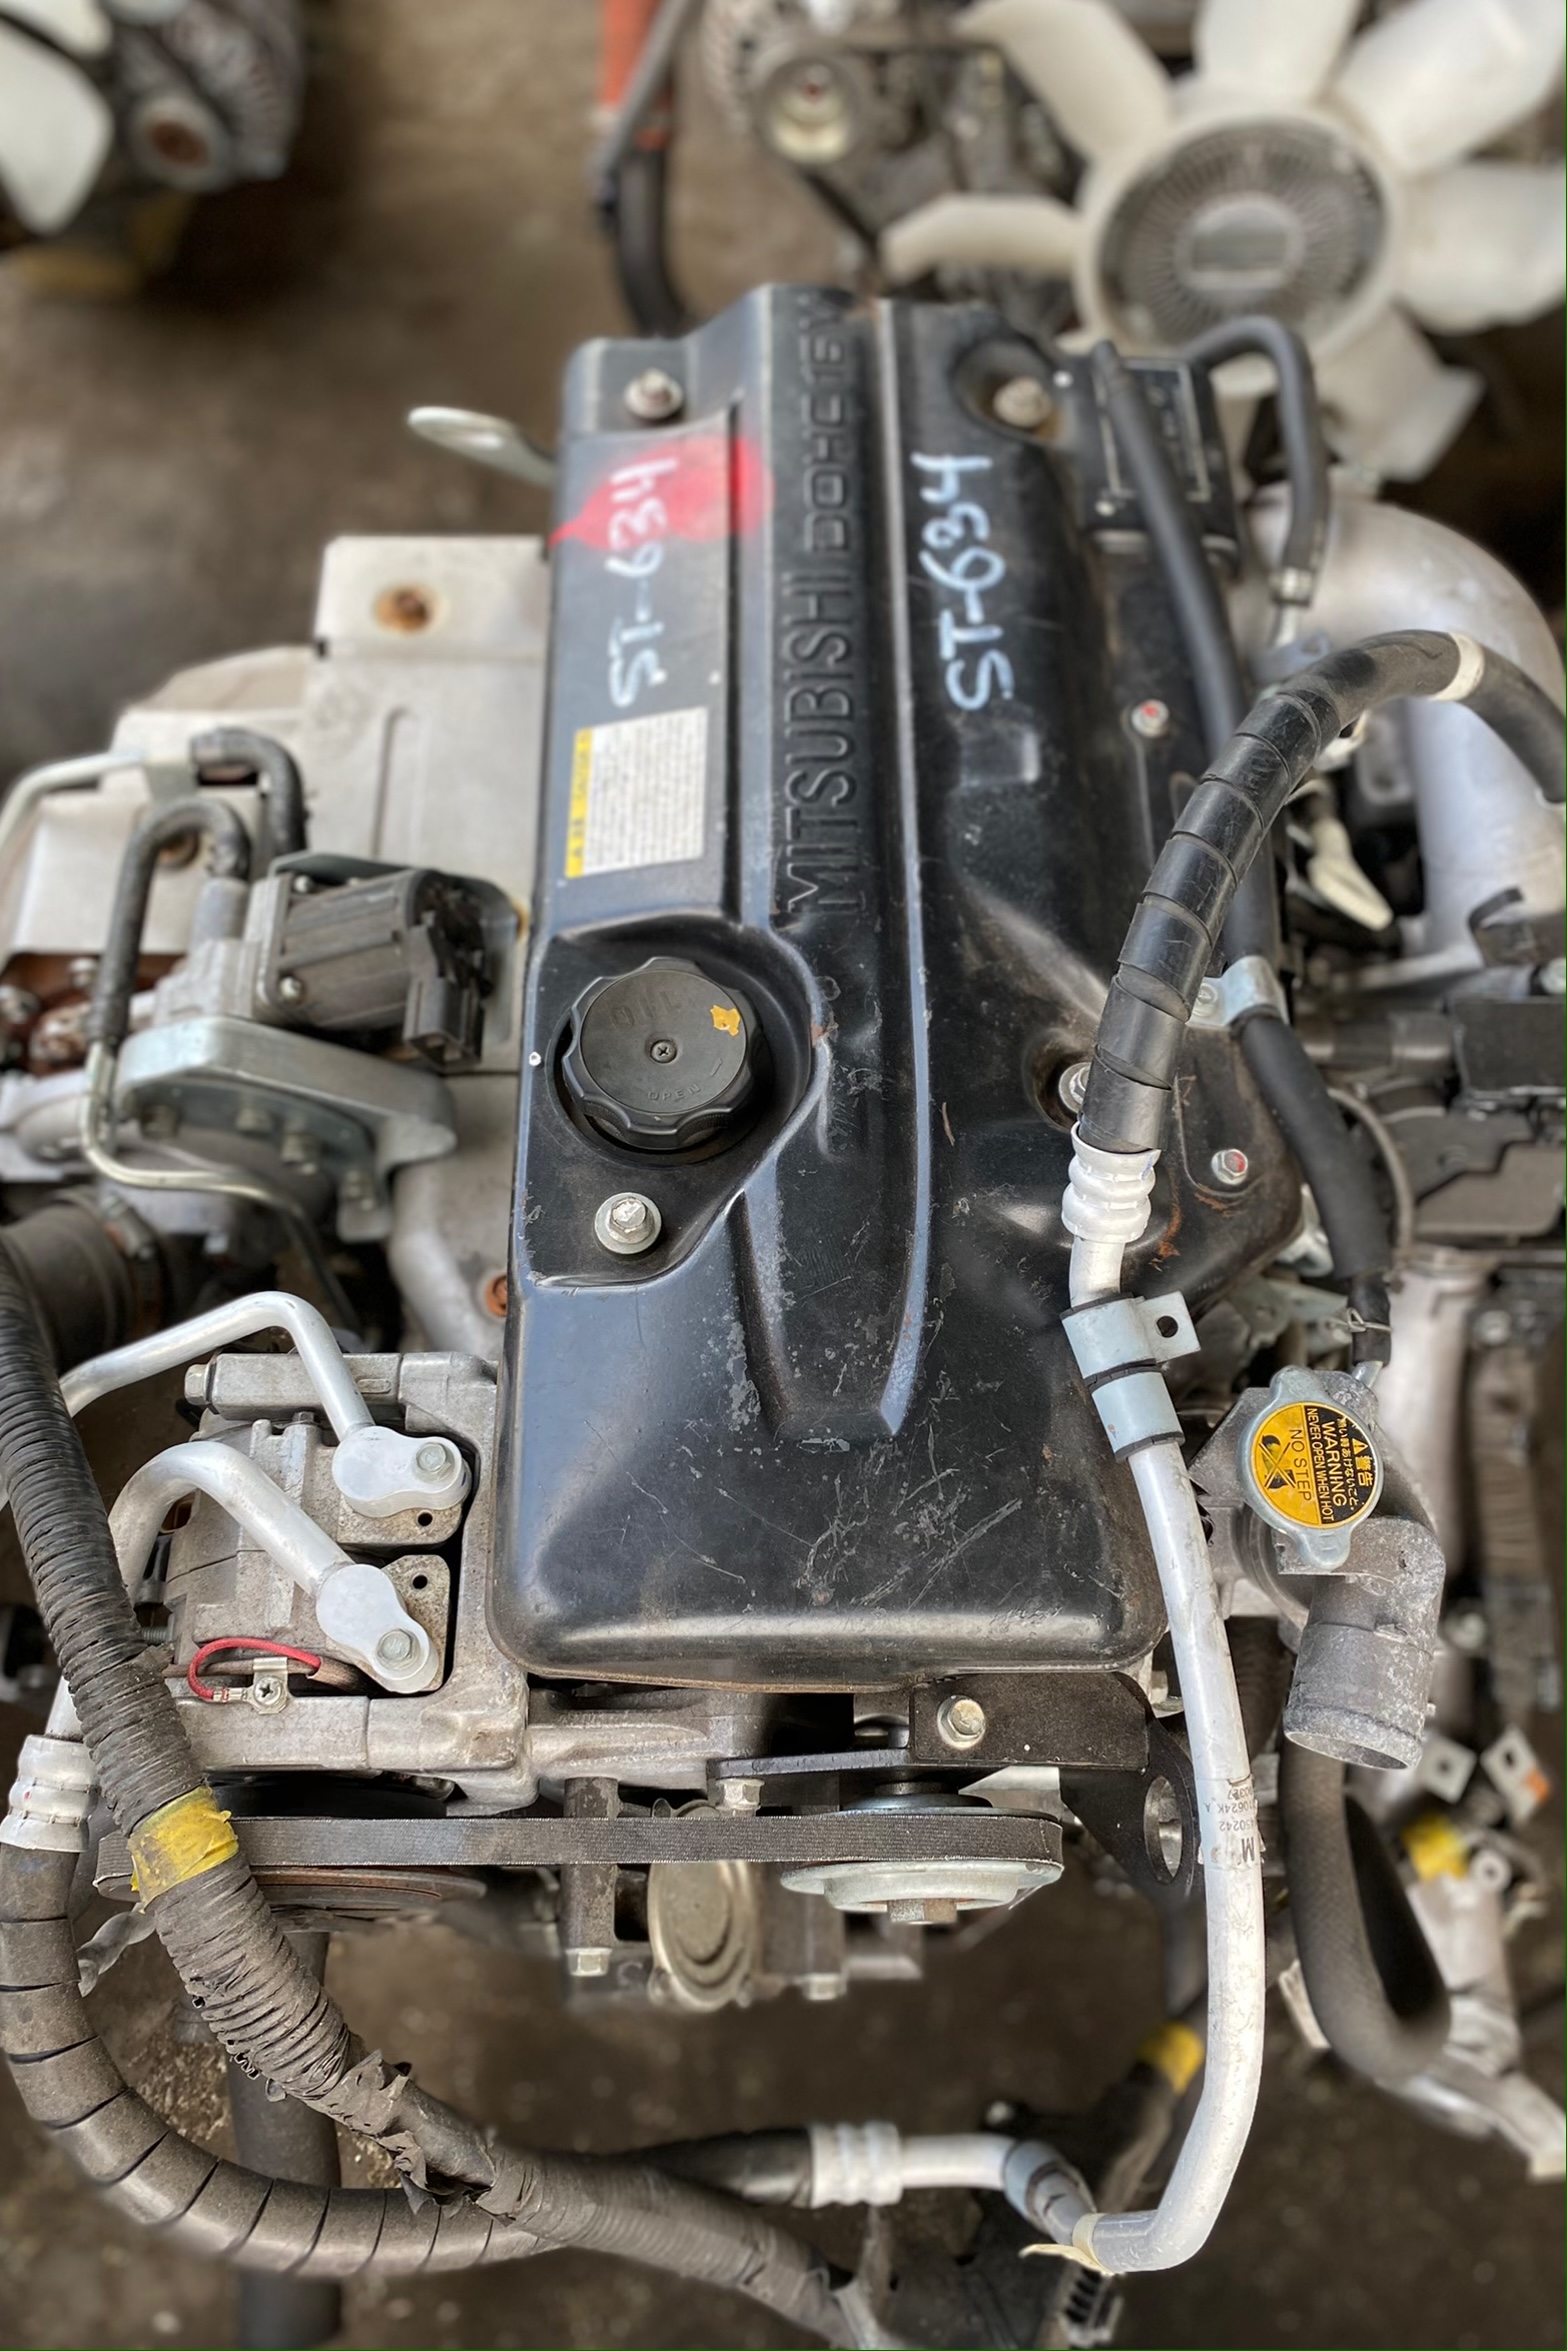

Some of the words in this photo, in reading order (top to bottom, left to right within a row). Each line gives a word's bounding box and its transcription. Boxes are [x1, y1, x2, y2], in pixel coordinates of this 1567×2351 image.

[802, 393, 851, 553] DOHC
[606, 457, 679, 708] ST-634
[911, 451, 1016, 713] ST-634
[782, 571, 862, 916] MITSUBISHI
[609, 990, 683, 1029] OIL
[647, 1083, 702, 1101] OPEN
[1288, 1428, 1305, 1453] NO
[1306, 1407, 1322, 1440] NEVER
[1311, 1441, 1327, 1469] OPEN
[1321, 1421, 1348, 1507] WARNING
[1355, 1455, 1374, 1487] 警告
[1293, 1457, 1312, 1502] STEP
[1315, 1469, 1331, 1499] WHEN
[1320, 1500, 1335, 1522] HOT
